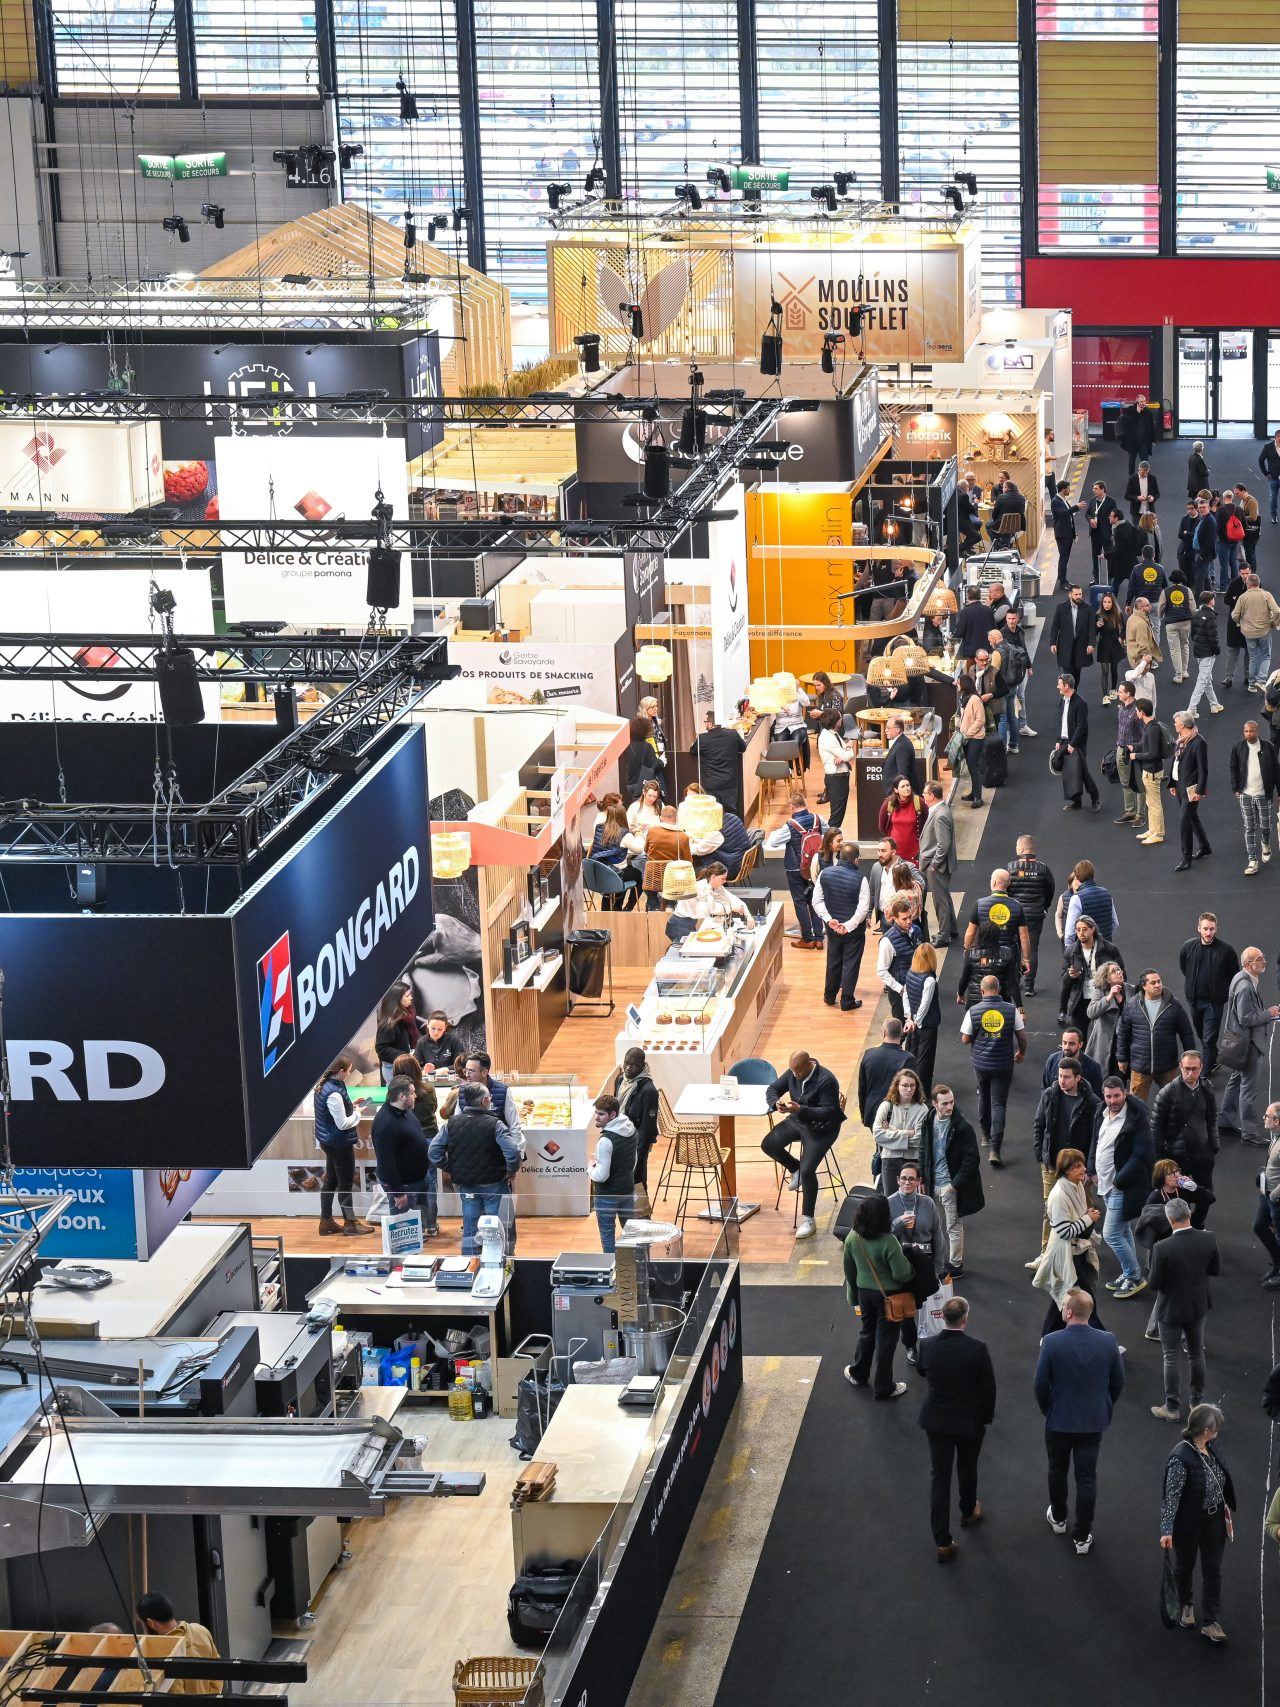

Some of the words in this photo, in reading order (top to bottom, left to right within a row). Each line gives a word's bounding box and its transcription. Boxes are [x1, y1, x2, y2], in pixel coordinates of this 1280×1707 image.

[185, 157, 216, 169] SORTIE
[182, 170, 191, 178] DE
[192, 168, 220, 178] SECOURS
[748, 171, 778, 182] SORTIE
[743, 181, 752, 190] DE
[753, 181, 782, 190] SECOURS
[818, 271, 909, 303] MOULINS
[818, 307, 909, 330] SOUFLET
[0, 491, 70, 503] MANN
[244, 550, 297, 566] Délice
[300, 552, 314, 566] &
[315, 551, 370, 566] Créati
[313, 570, 352, 579] pomona
[673, 629, 711, 638] Façonnons
[513, 658, 555, 666] Savoyarde
[478, 671, 526, 679] PRODUITS
[530, 672, 542, 680] DE
[544, 672, 594, 680] SNACKING
[297, 845, 420, 1035] BONGARD
[0, 1039, 166, 1101] RD
[521, 1166, 544, 1174] Délice
[552, 1165, 585, 1174] Création
[57, 1213, 107, 1231] bon.
[390, 1227, 419, 1239] Recrutez
